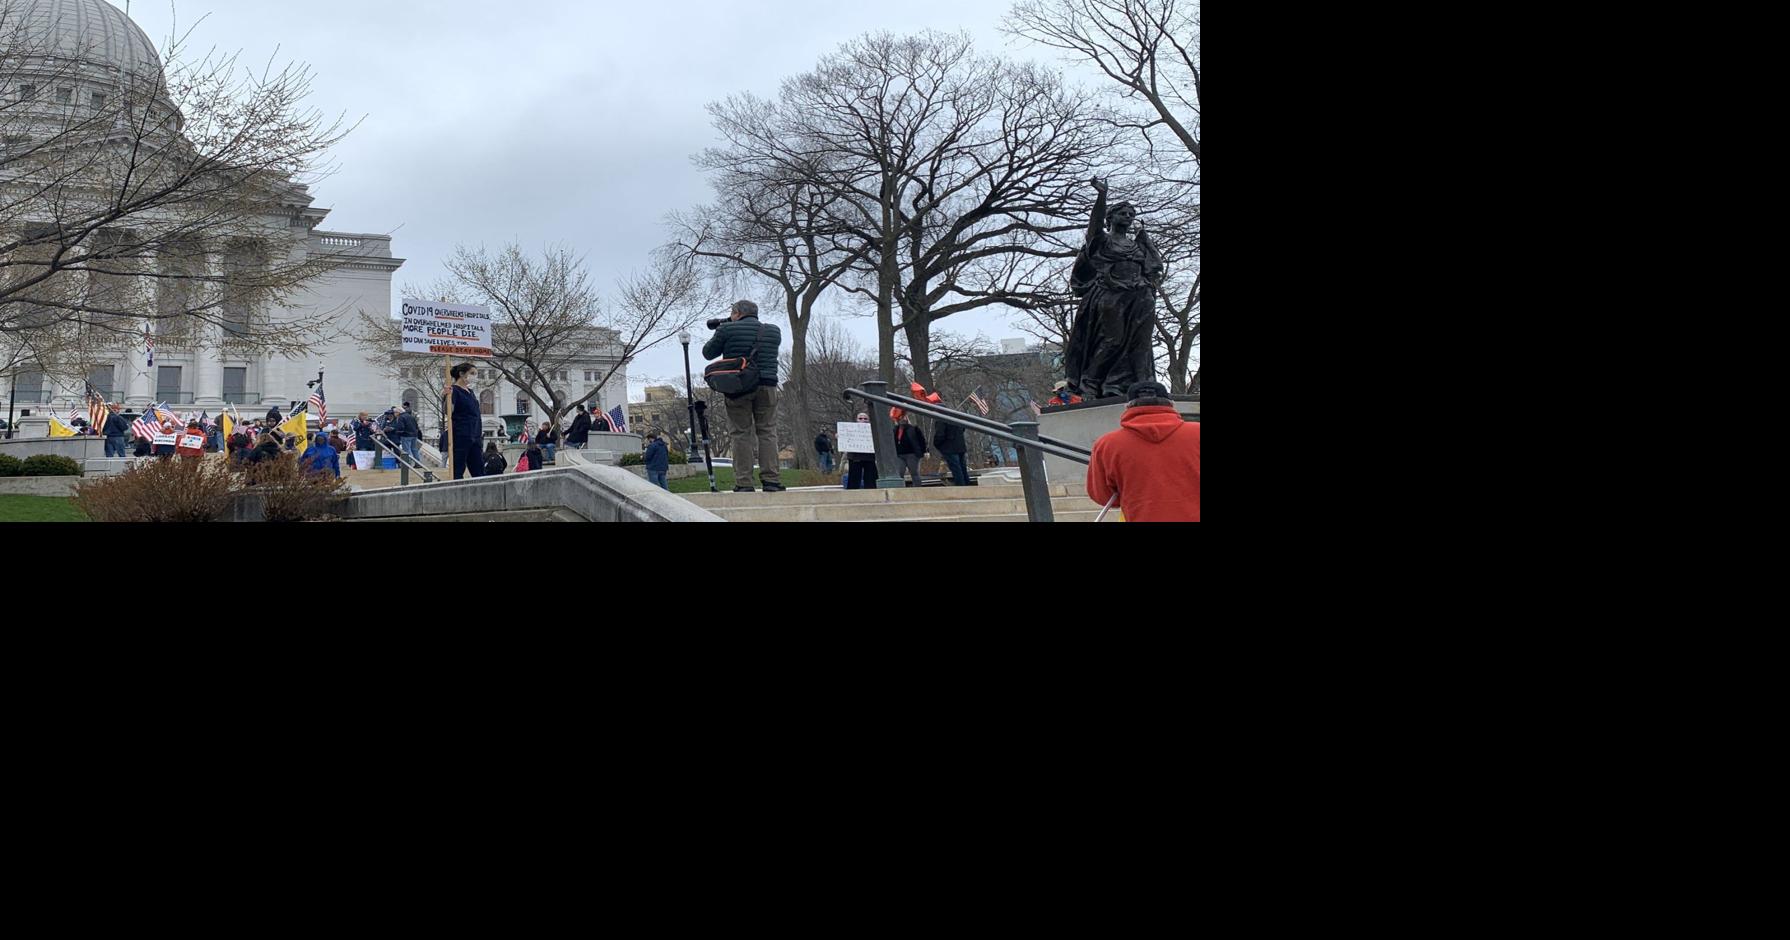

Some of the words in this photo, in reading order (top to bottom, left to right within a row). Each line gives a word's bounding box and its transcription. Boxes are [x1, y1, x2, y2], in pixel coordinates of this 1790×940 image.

[402, 303, 426, 316] COVID
[426, 307, 433, 317] 19
[413, 318, 452, 328] OVERWHELMED
[402, 324, 423, 333] MORE
[427, 326, 458, 336] PEOPLE
[413, 337, 424, 345] CAN
